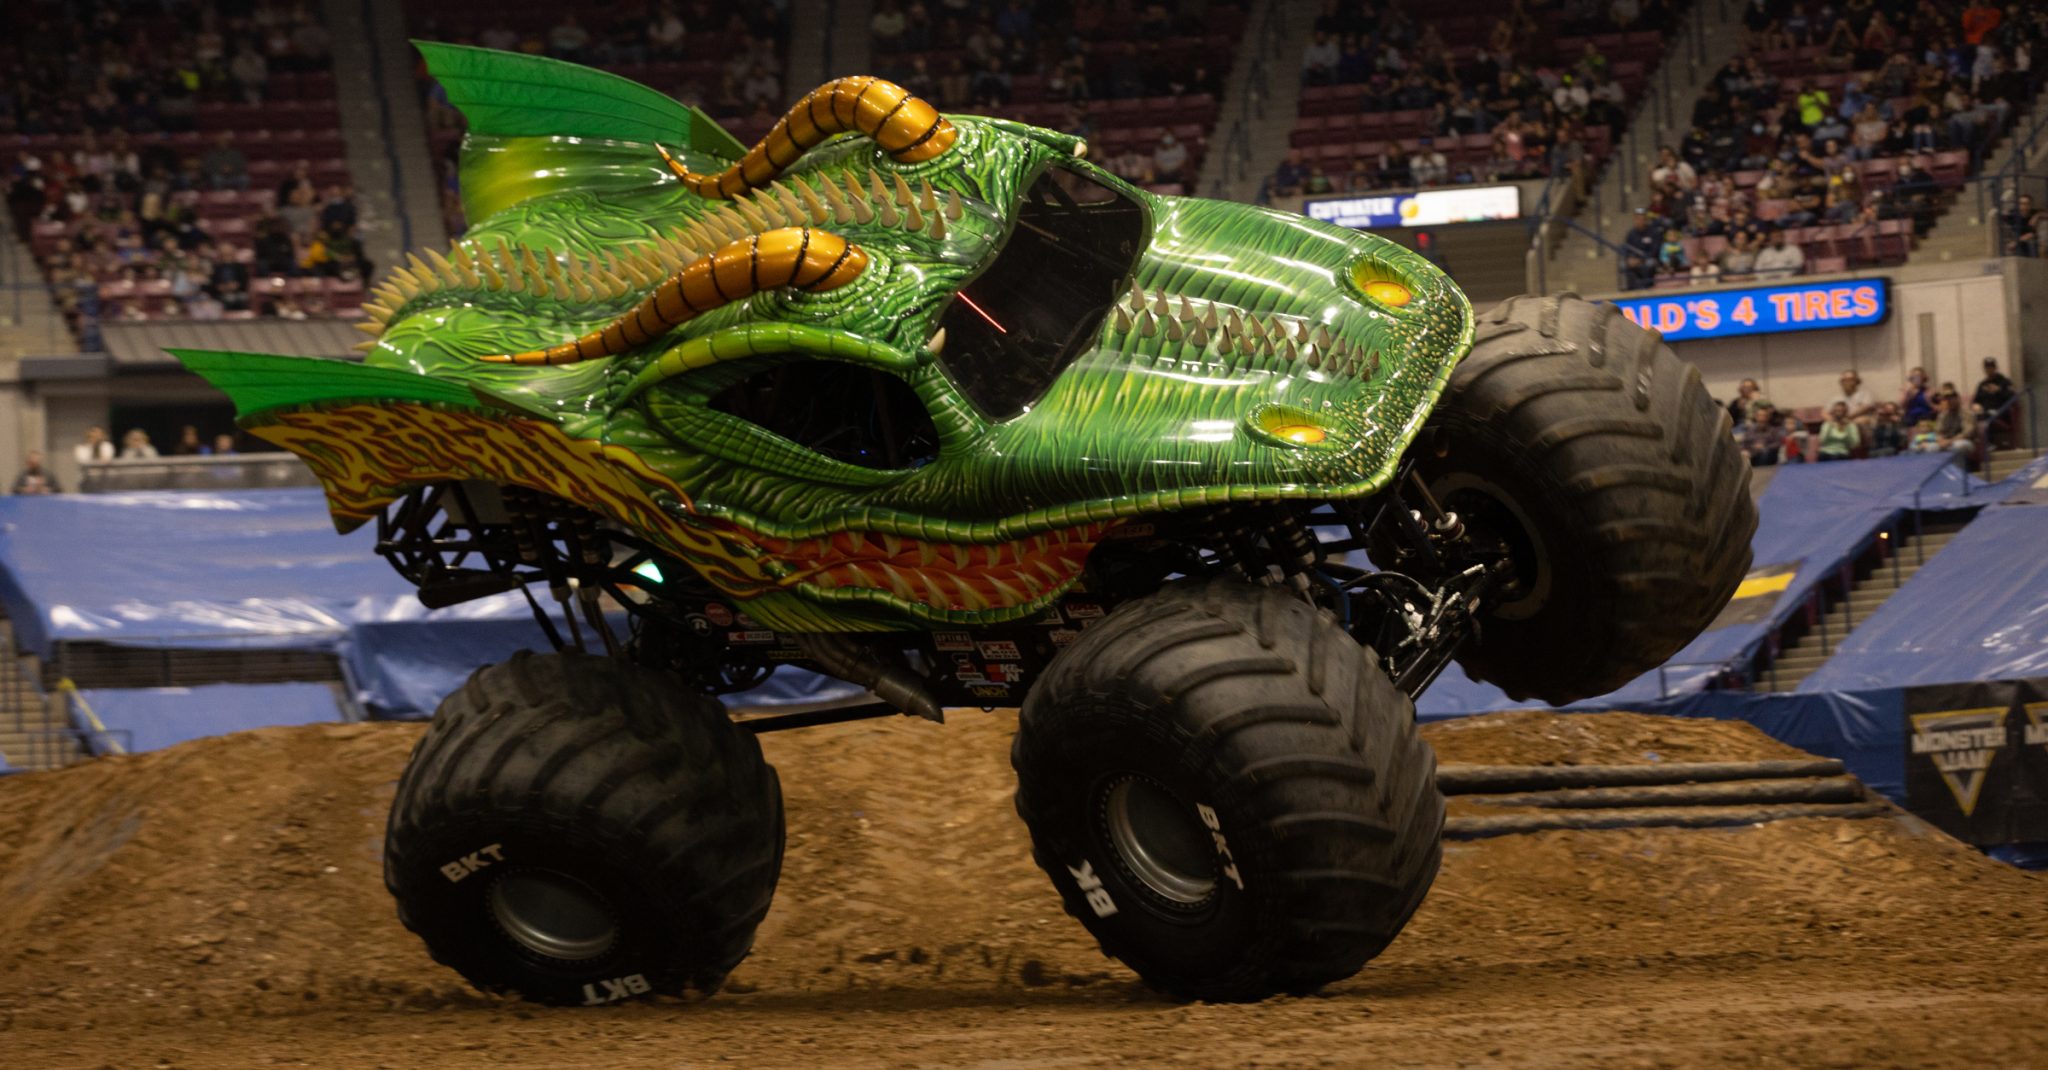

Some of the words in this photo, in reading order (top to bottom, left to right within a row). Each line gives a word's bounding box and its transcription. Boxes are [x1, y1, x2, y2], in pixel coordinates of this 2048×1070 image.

[1731, 296, 1758, 326] 4
[1769, 286, 1879, 323] TIRES
[1911, 726, 2008, 754] MONSTER
[1940, 750, 1988, 771] JAM
[440, 843, 504, 883] BKT
[1197, 802, 1244, 890] BKT
[582, 973, 650, 1006] BKT
